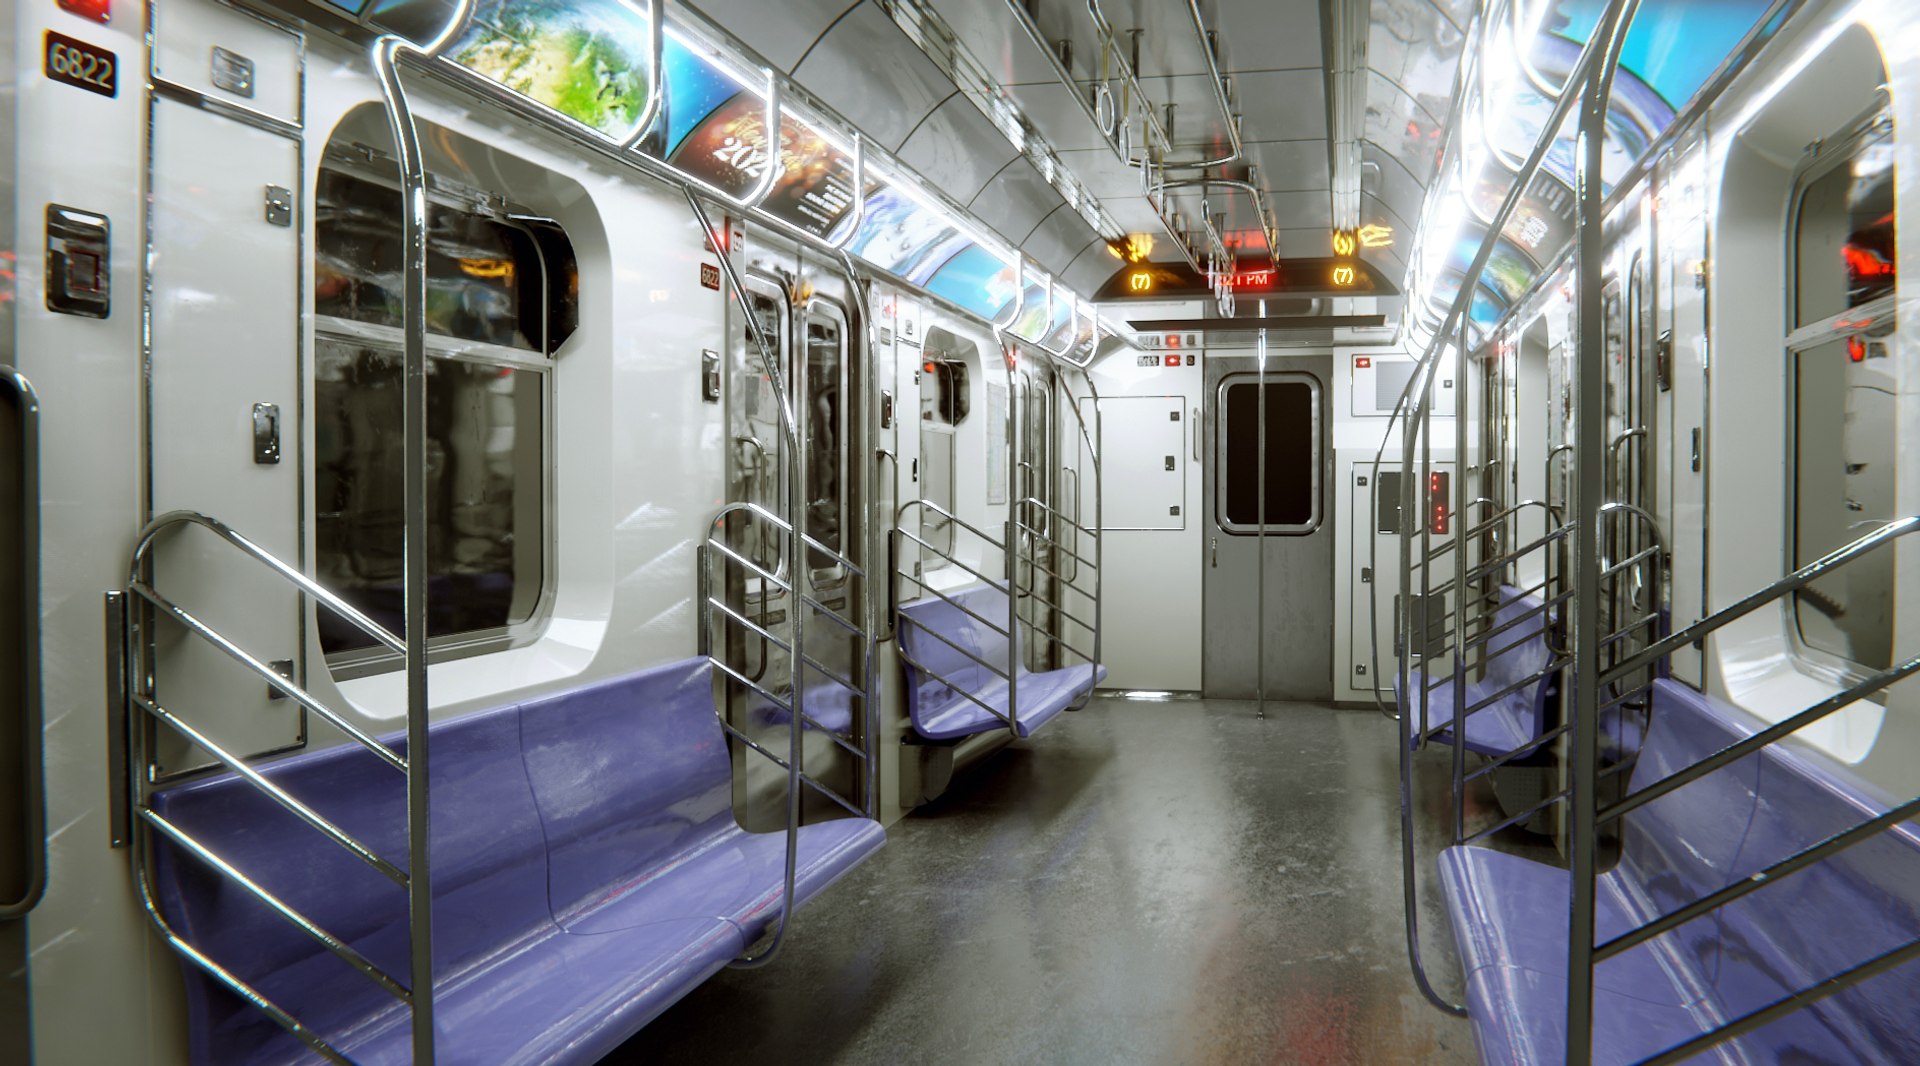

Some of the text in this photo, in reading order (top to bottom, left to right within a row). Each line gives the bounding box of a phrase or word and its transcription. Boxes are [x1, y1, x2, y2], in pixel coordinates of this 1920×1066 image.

[49, 41, 113, 90] 6822
[702, 267, 719, 287] 6822
[1246, 274, 1268, 286] PM
